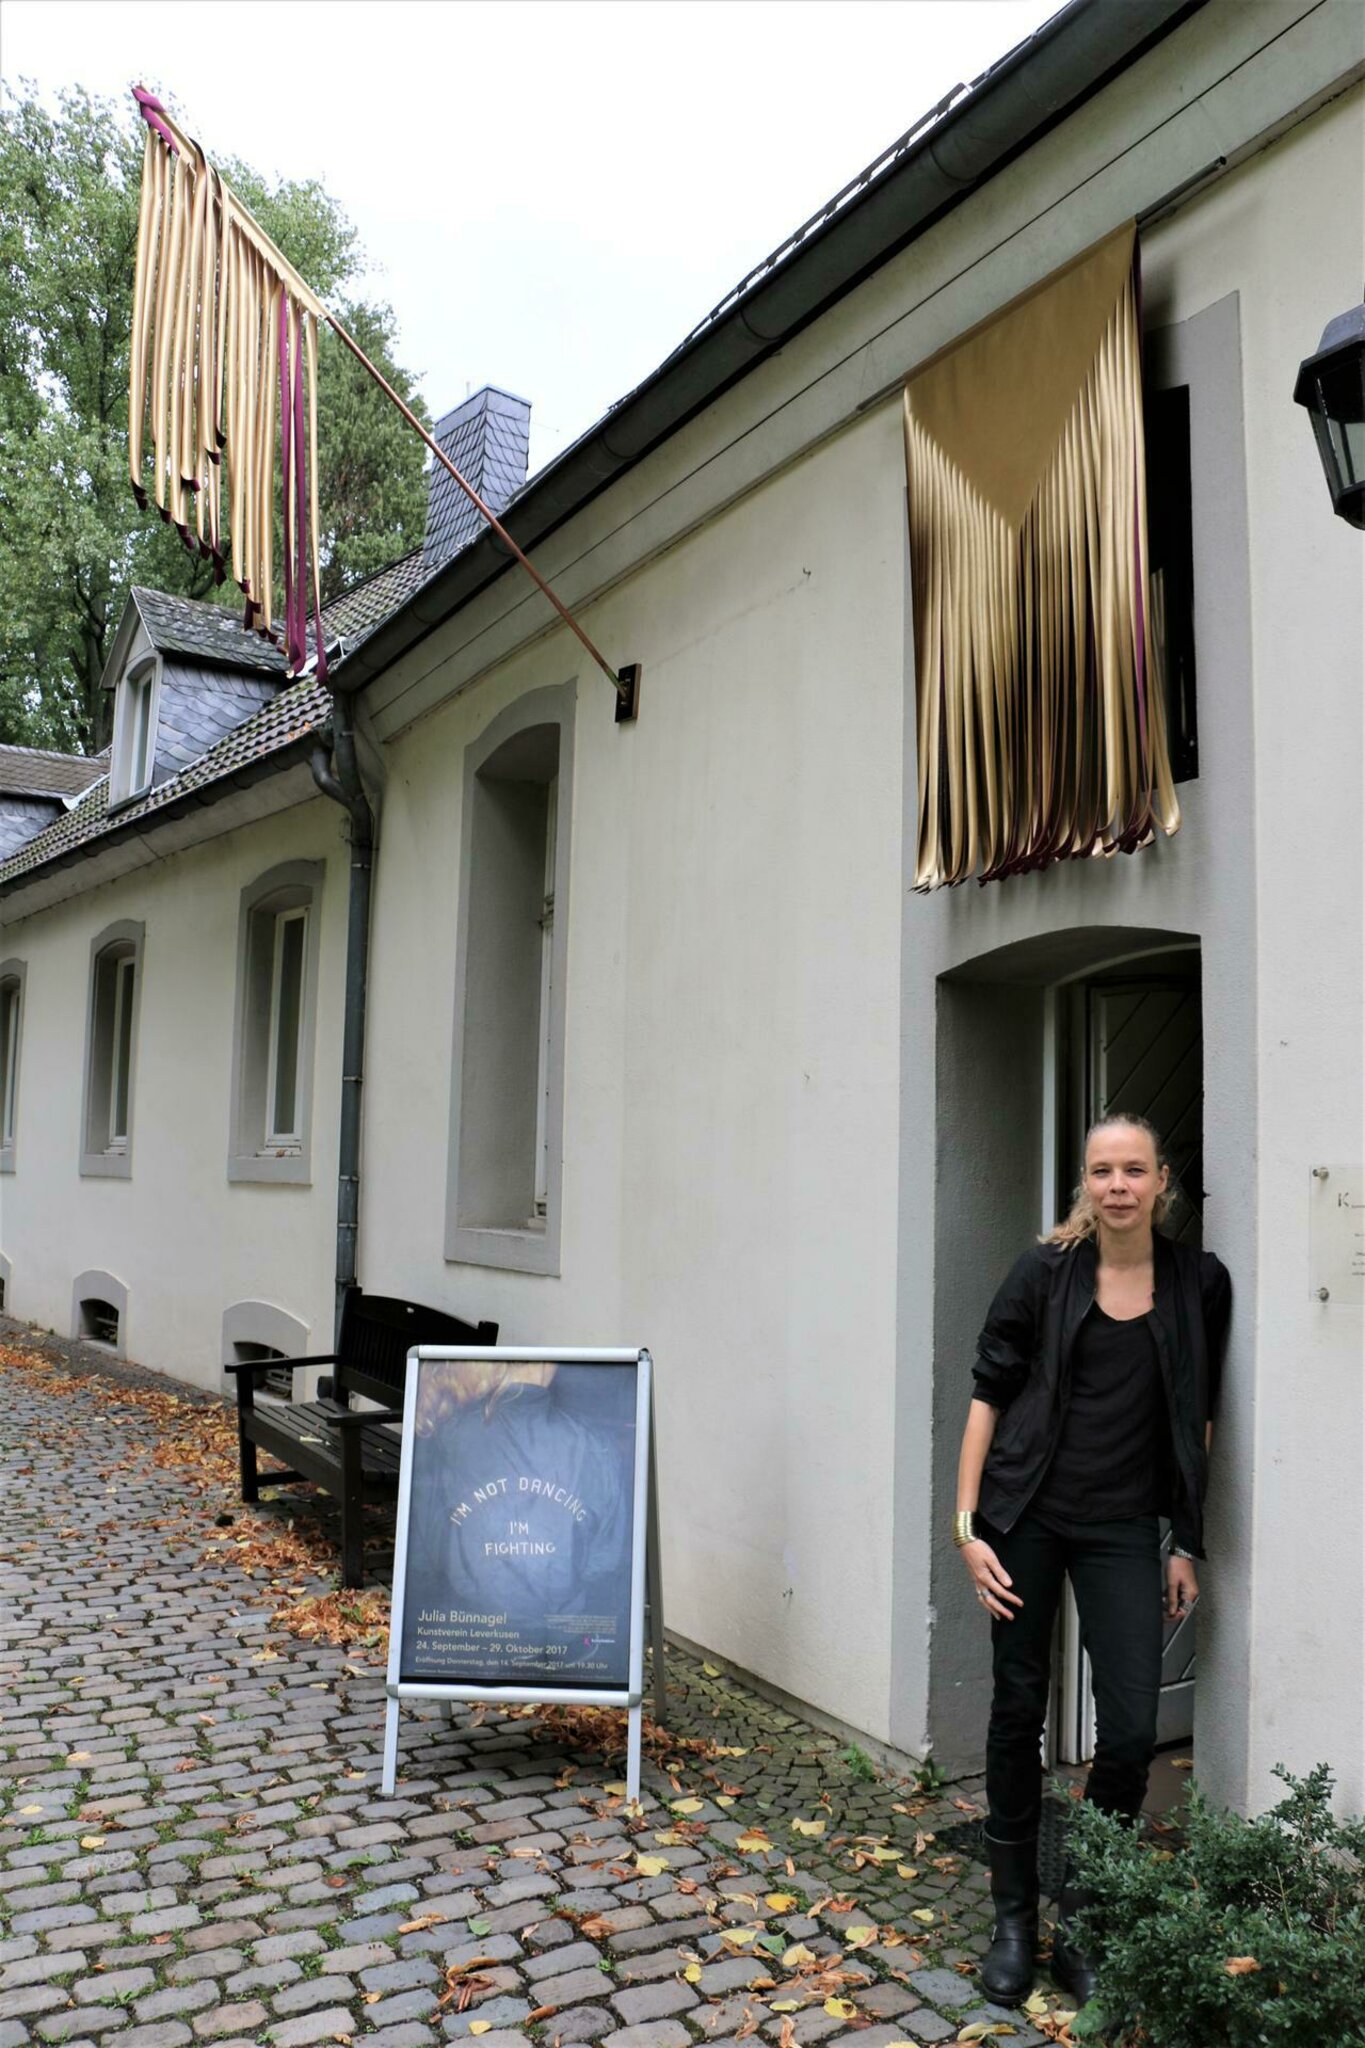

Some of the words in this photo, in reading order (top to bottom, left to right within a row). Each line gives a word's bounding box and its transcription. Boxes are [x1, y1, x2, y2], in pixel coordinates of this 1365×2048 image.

[450, 1502, 472, 1526] I'M
[473, 1478, 508, 1503] NOT
[519, 1477, 586, 1521] DANCING
[509, 1521, 529, 1535] I'M
[484, 1542, 556, 1555] FIGHTING
[418, 1609, 446, 1622] Julia
[450, 1610, 507, 1627] Bünnagel
[417, 1627, 467, 1637] Kunstverein
[470, 1629, 519, 1639] Leverkusen
[416, 1640, 429, 1650] 24.
[432, 1641, 480, 1652] September
[489, 1643, 503, 1653] 29.
[505, 1643, 543, 1653] Oktober
[545, 1645, 568, 1655] 2017
[415, 1656, 445, 1665] Eröffnung
[511, 1660, 547, 1670] September
